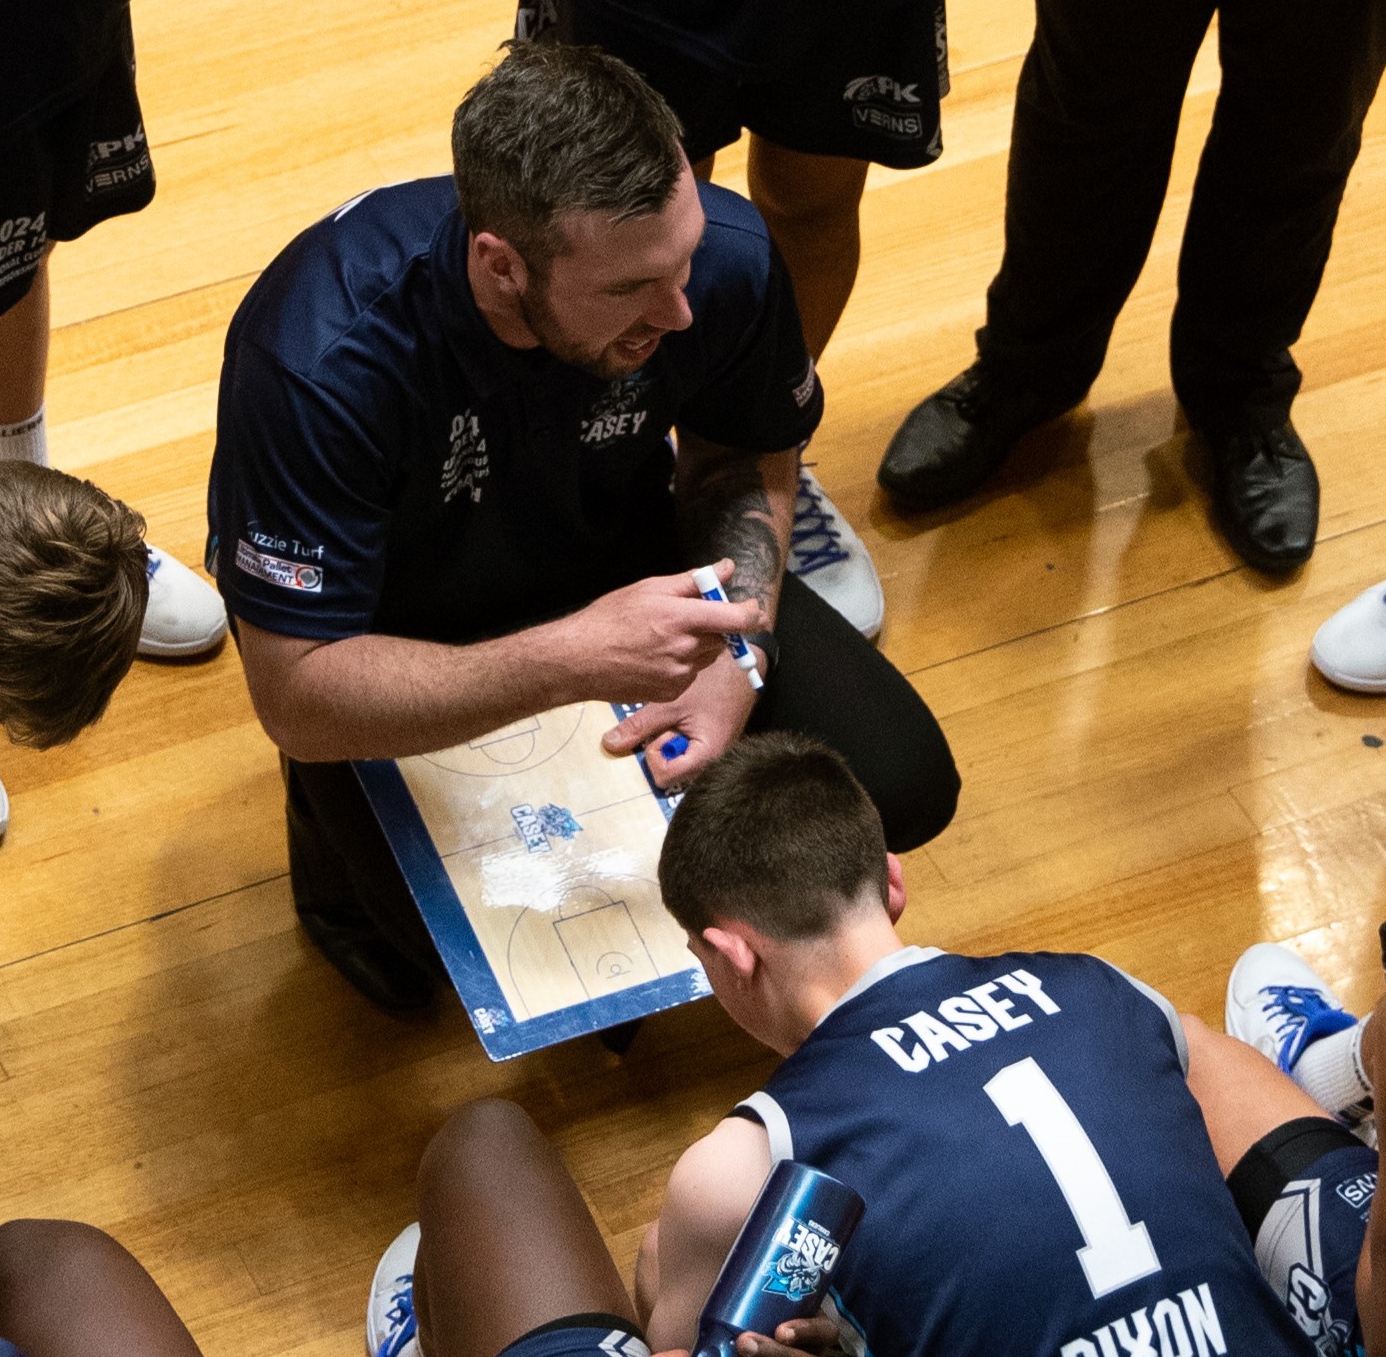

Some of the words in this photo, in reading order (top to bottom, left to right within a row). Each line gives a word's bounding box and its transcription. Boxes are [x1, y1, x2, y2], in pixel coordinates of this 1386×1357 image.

[292, 539, 324, 560] Turf
[870, 968, 1061, 1074] CASEY
[982, 1056, 1162, 1301] 1
